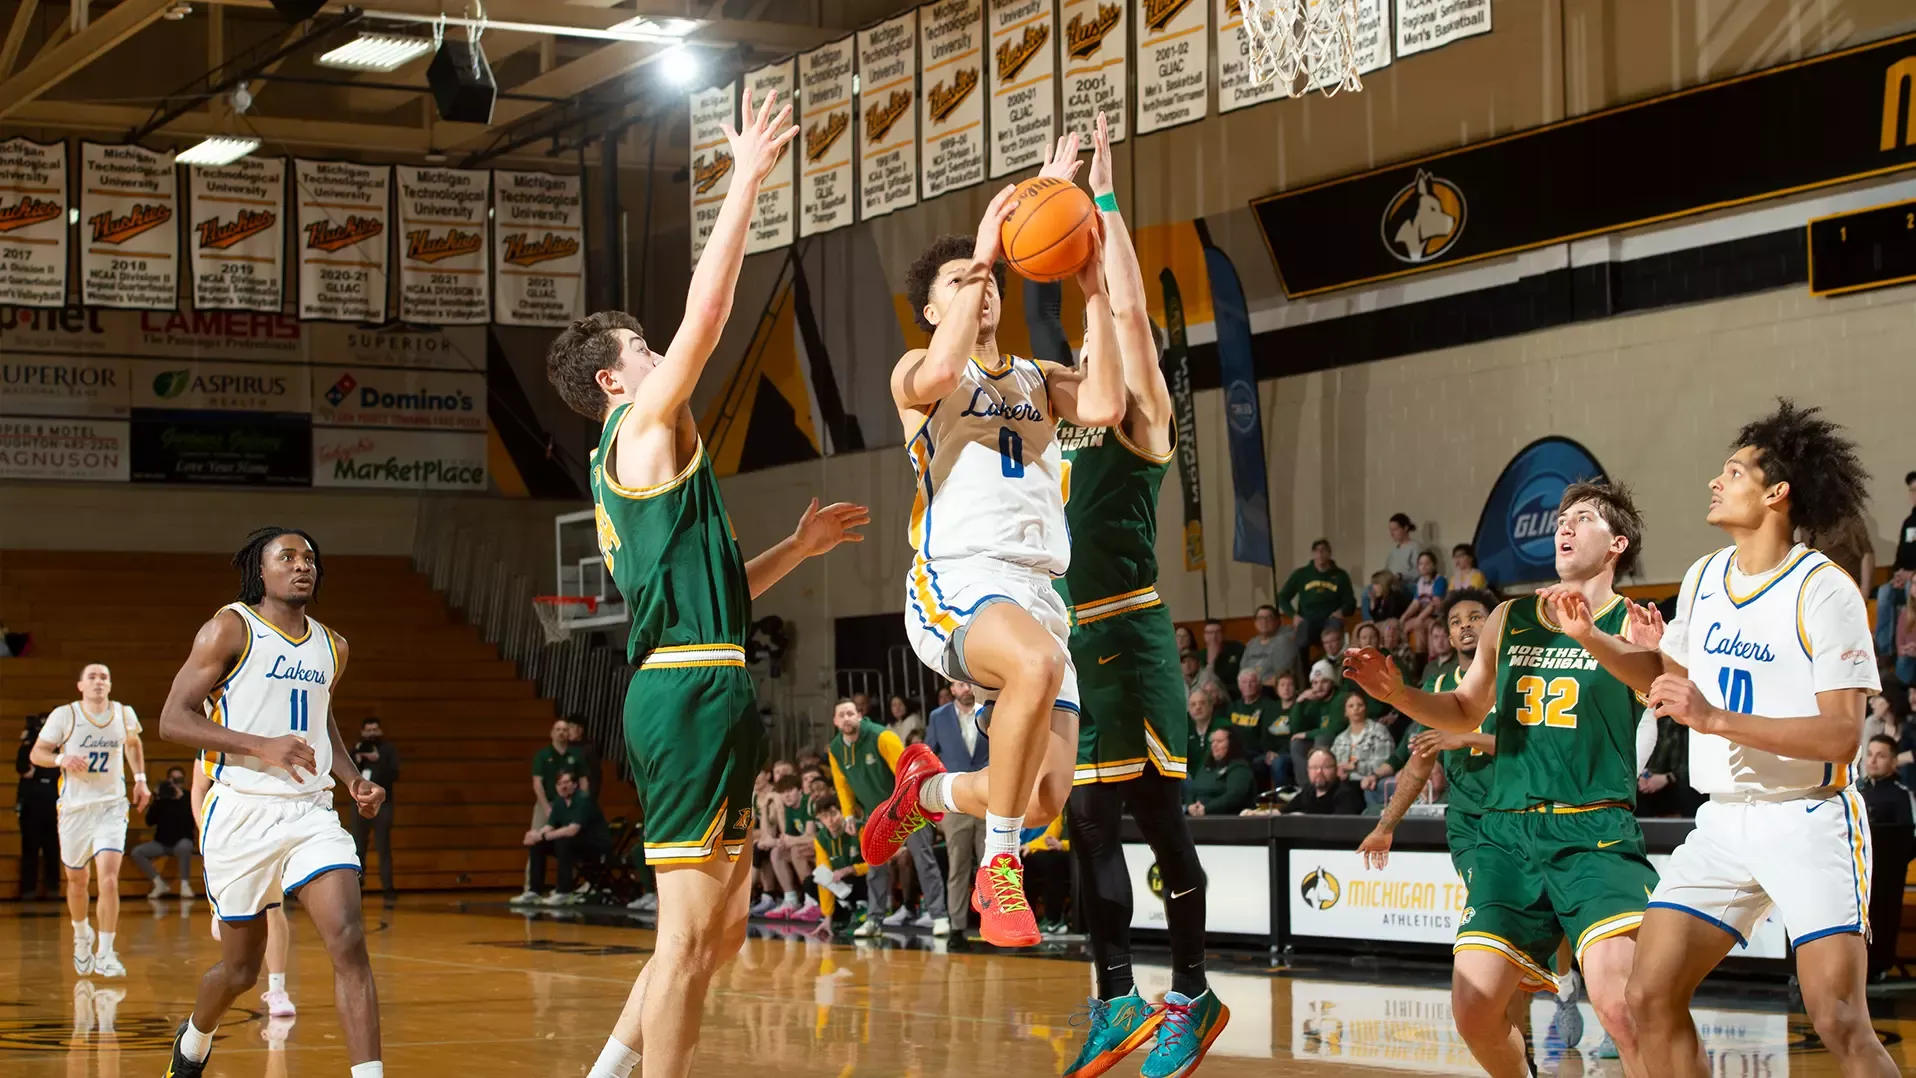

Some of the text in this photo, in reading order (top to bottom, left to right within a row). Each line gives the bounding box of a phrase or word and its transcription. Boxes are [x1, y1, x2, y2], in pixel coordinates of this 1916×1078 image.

[933, 0, 968, 21] Michigan
[1000, 3, 1040, 25] University
[1402, 8, 1437, 29] Regional
[924, 5, 980, 40] Technological
[1404, 10, 1484, 46] Men's Basketball
[870, 25, 903, 46] Michigan
[863, 34, 912, 65] Technological
[931, 34, 972, 59] University
[869, 60, 904, 83] University
[1166, 71, 1202, 92] Basketball
[809, 84, 843, 104] University
[1156, 108, 1189, 123] Champions
[104, 150, 156, 164] Michigan
[88, 160, 172, 176] Technological
[196, 168, 279, 184] Technological
[317, 165, 369, 177] Michigan
[100, 176, 158, 190] University
[207, 182, 267, 197] University
[302, 173, 384, 189] Technological
[417, 171, 470, 188] Michigan
[514, 176, 566, 189] Michigan
[315, 188, 372, 201] University
[403, 185, 484, 204] Technological
[500, 189, 579, 207] Technological
[0, 196, 62, 229] uskies
[415, 202, 473, 219] University
[511, 207, 568, 223] University
[88, 204, 172, 244] Huskies
[195, 209, 276, 249] Huskies
[305, 215, 383, 253] Huskies
[3, 248, 32, 260] 2017
[407, 229, 482, 264] Huskies
[503, 233, 579, 267] Huskies
[112, 260, 146, 270] 2018
[222, 264, 253, 273] 2019
[120, 273, 160, 282] Division
[431, 275, 458, 283] 2021
[528, 278, 554, 287] 2021
[326, 284, 360, 293] GLIAC
[348, 333, 450, 353] SUPERIOR
[3, 364, 117, 388] UPERIOR
[190, 374, 286, 396] ASPIRUS
[360, 387, 473, 411] Domino's
[961, 387, 1043, 422] Lakers
[50, 426, 96, 437] MOTEL
[0, 451, 118, 468] AGNUSON
[999, 426, 1024, 479] 0
[334, 456, 483, 484] MarketPlace
[1704, 621, 1775, 663] Lakers
[265, 655, 327, 685] Lakers
[1508, 656, 1598, 671] MICHIGAN
[1718, 666, 1754, 714] 10
[290, 688, 308, 732] 11
[1516, 675, 1580, 729] 32
[79, 735, 119, 749] Lakers
[87, 752, 109, 773] 22
[1348, 880, 1468, 912] MICHIGAN TE
[1383, 913, 1451, 928] ATHLETICS
